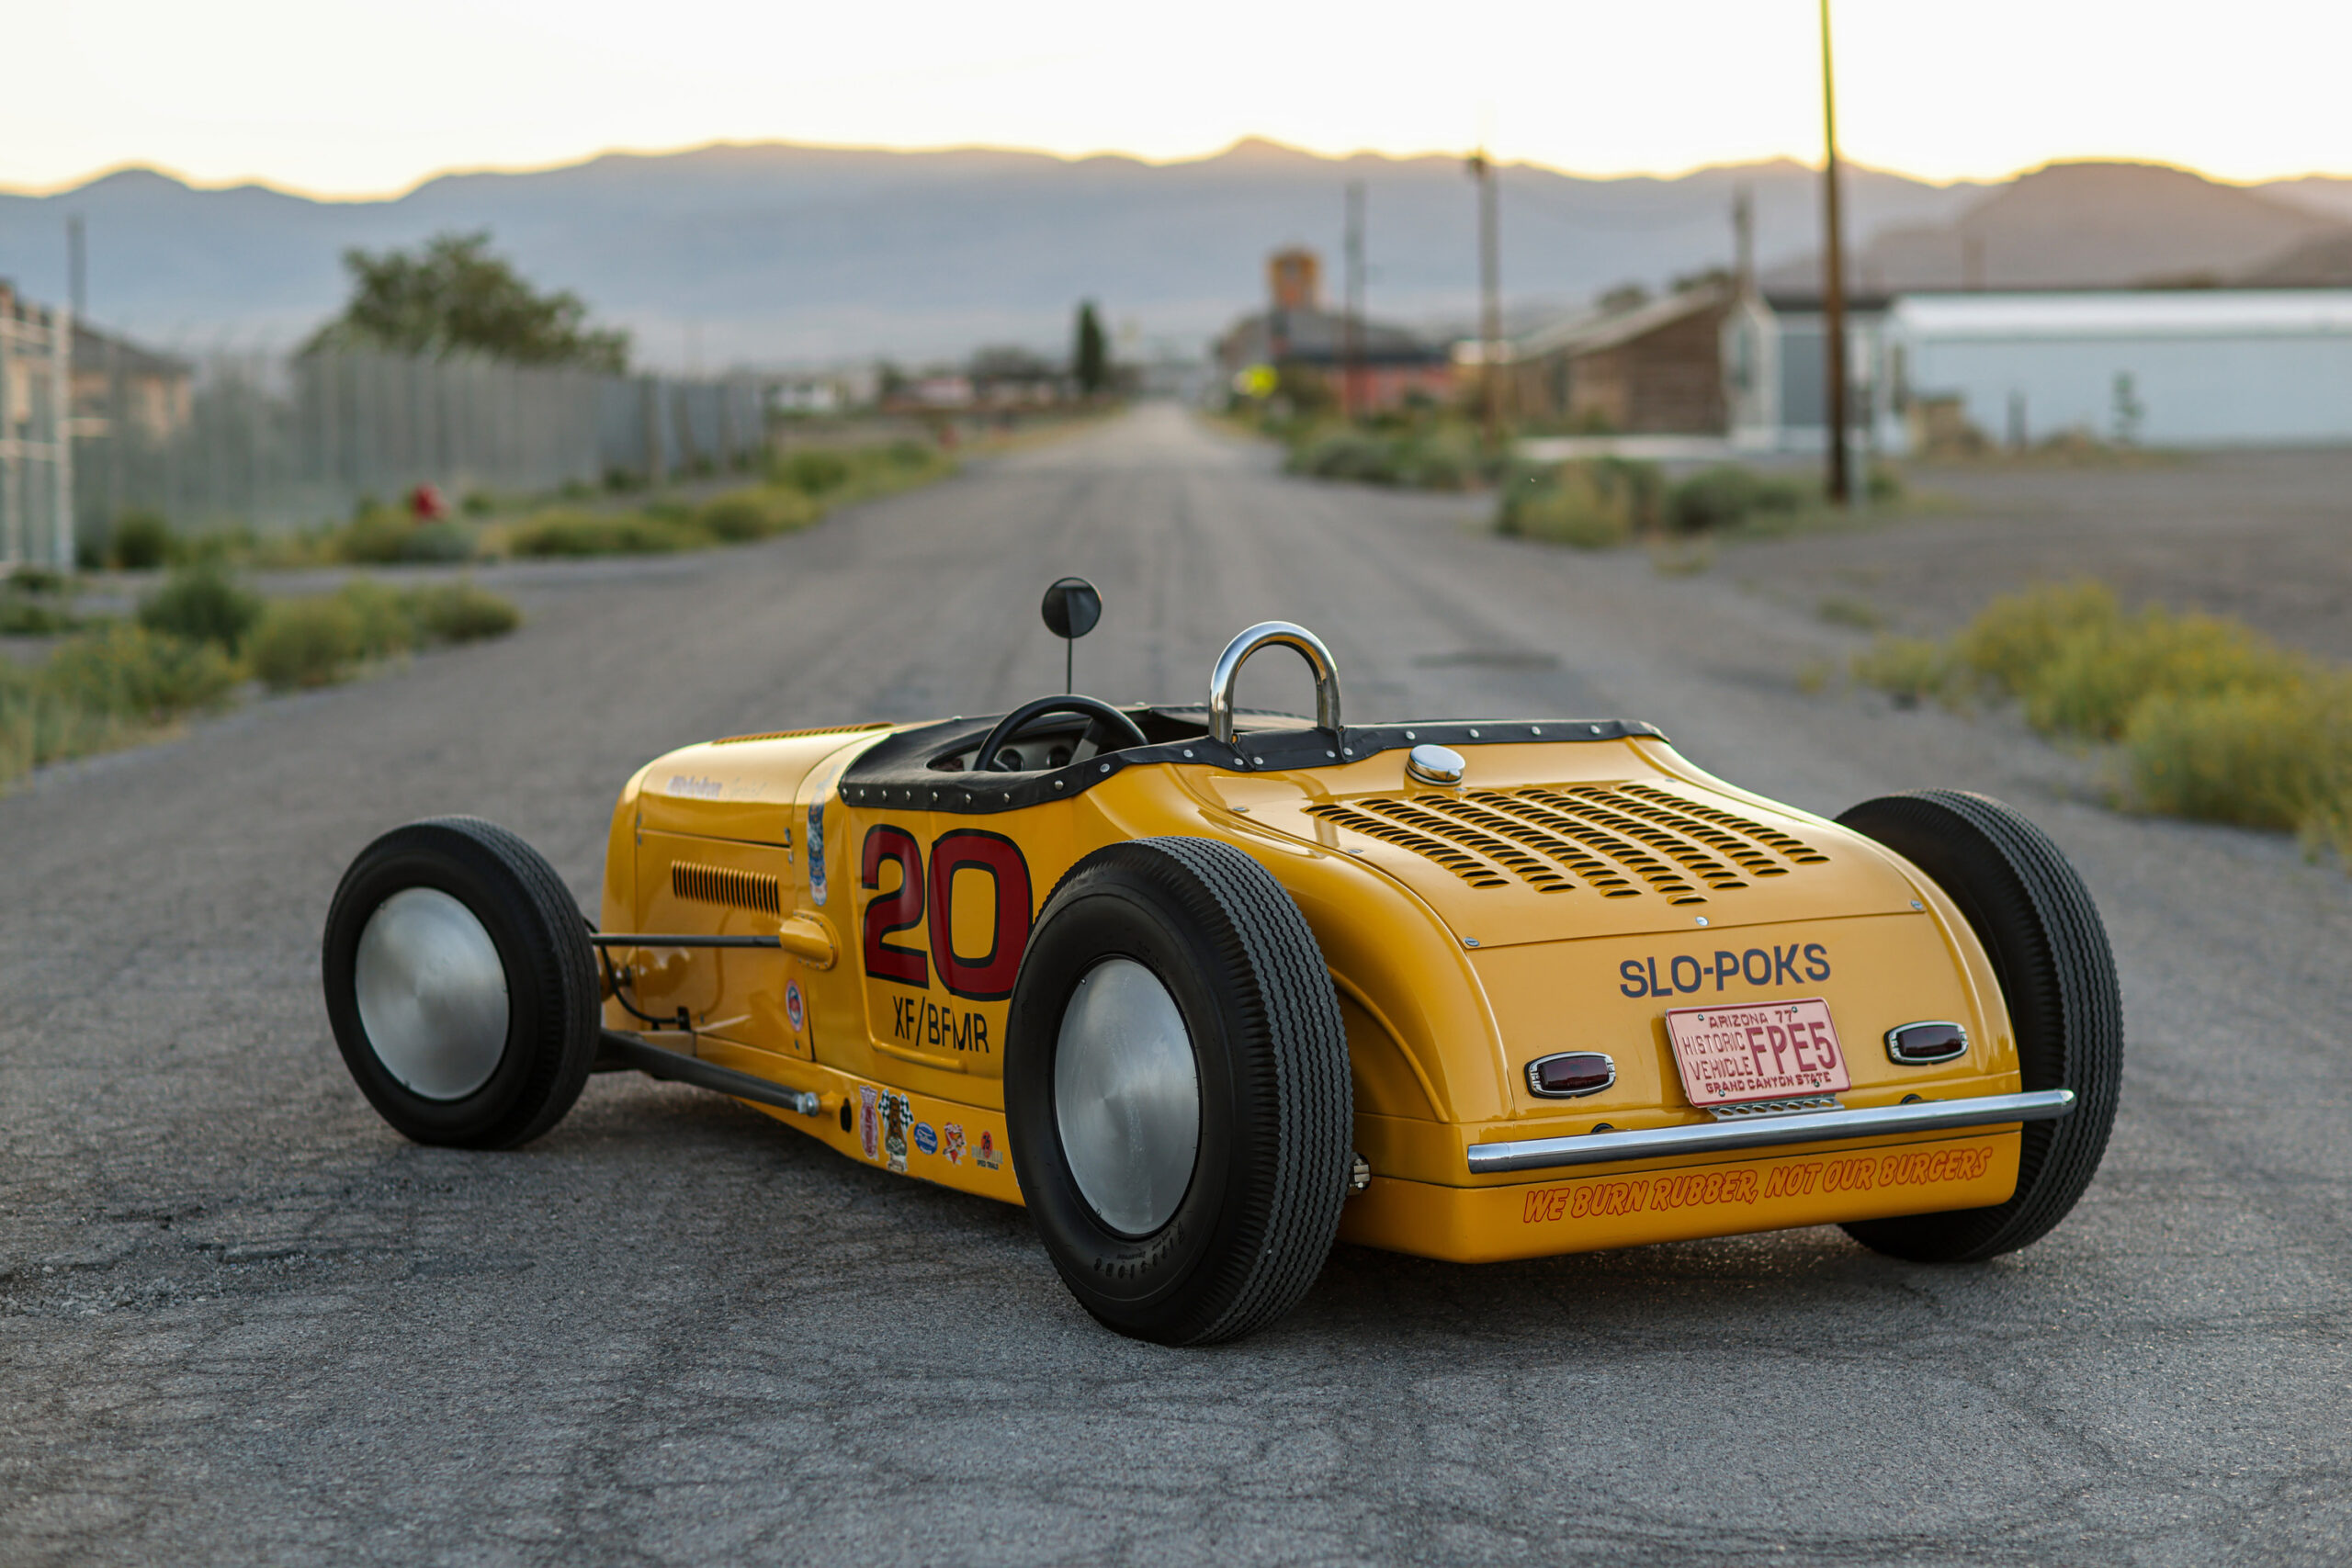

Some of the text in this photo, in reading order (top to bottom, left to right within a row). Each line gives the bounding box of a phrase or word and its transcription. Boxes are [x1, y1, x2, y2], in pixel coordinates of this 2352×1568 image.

[861, 824, 1034, 1002] 20
[1620, 943, 1831, 998] SLO-POKS
[893, 995, 989, 1054] XF/BFMR
[1682, 1032, 1746, 1055] HISTORIC
[1709, 1010, 1792, 1029] ARIZONA 77
[1689, 1056, 1753, 1080] VEHICLE
[1746, 1021, 1837, 1077] FPE5
[1705, 1072, 1832, 1094] GRAND CANYON STATE
[1523, 1146, 1994, 1224] WE BURN RUBBER, NOT OUR BURGERS
